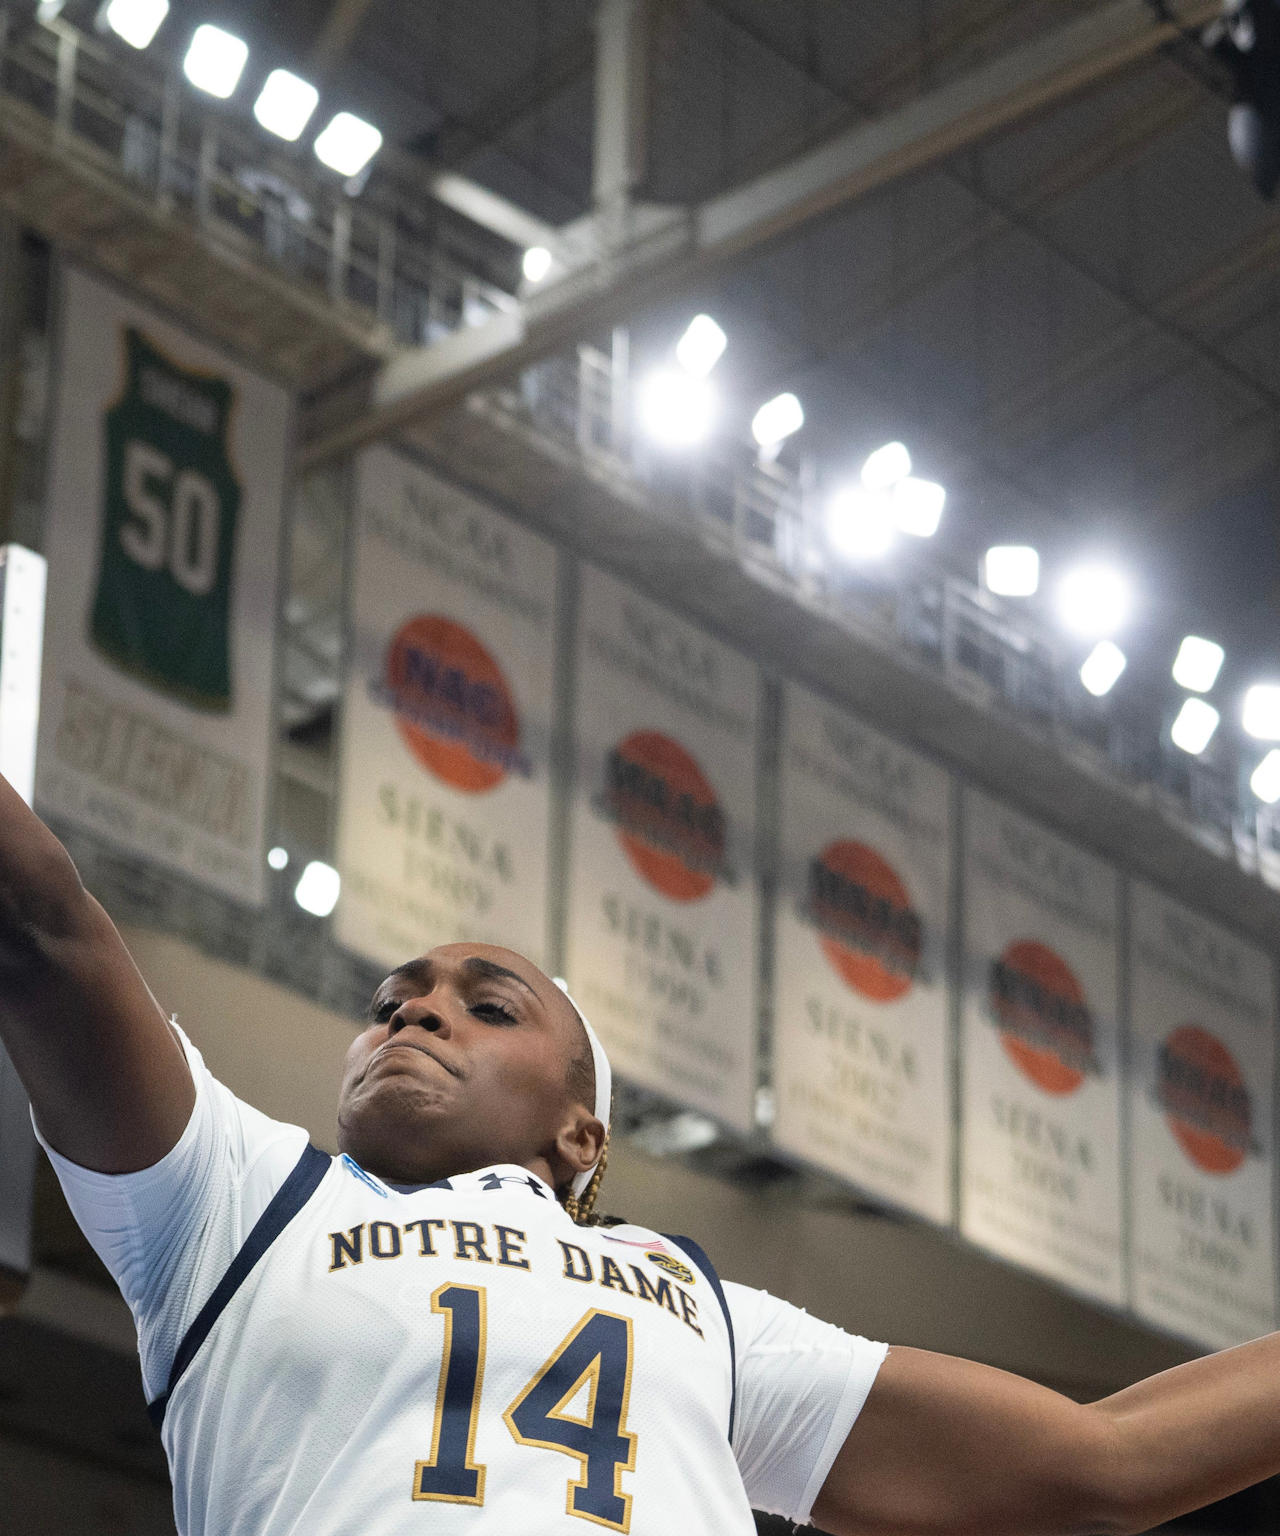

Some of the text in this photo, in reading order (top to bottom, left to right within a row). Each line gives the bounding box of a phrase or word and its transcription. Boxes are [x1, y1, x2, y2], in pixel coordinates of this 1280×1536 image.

[120, 447, 218, 593] 50
[327, 1218, 705, 1341] NOTRE DAME
[412, 1281, 638, 1535] 14
